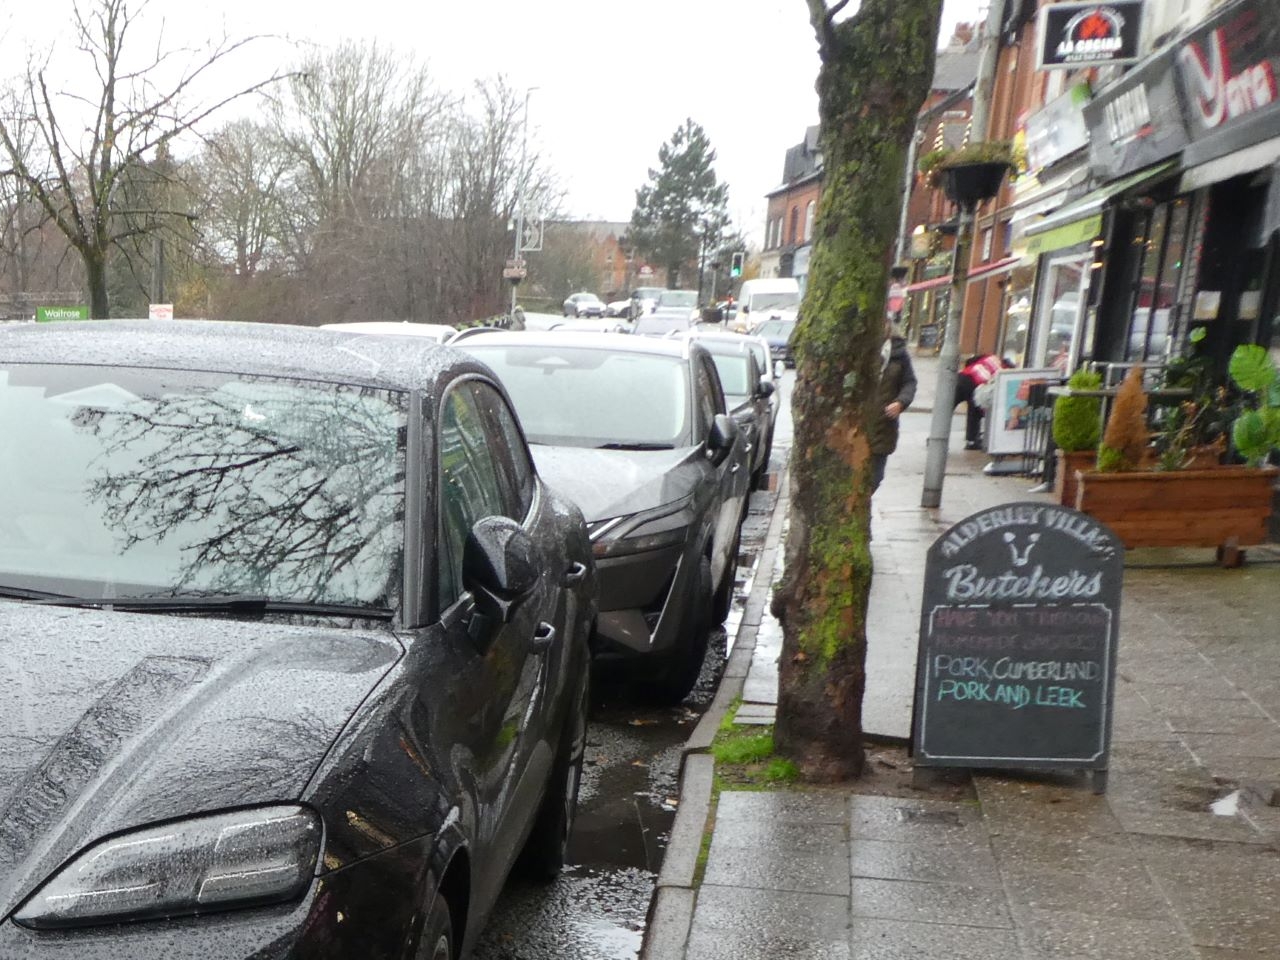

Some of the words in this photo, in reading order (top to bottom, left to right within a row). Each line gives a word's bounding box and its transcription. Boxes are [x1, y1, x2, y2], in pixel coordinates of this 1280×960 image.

[1056, 41, 1074, 55] LA
[1075, 36, 1122, 53] CUCINA
[45, 309, 80, 318] Waitrose
[942, 507, 1044, 558] ALDERLEY
[943, 564, 1103, 599] Butchers
[938, 679, 993, 701] PORK
[994, 684, 1030, 710] AND
[1035, 685, 1086, 708] LEEK
